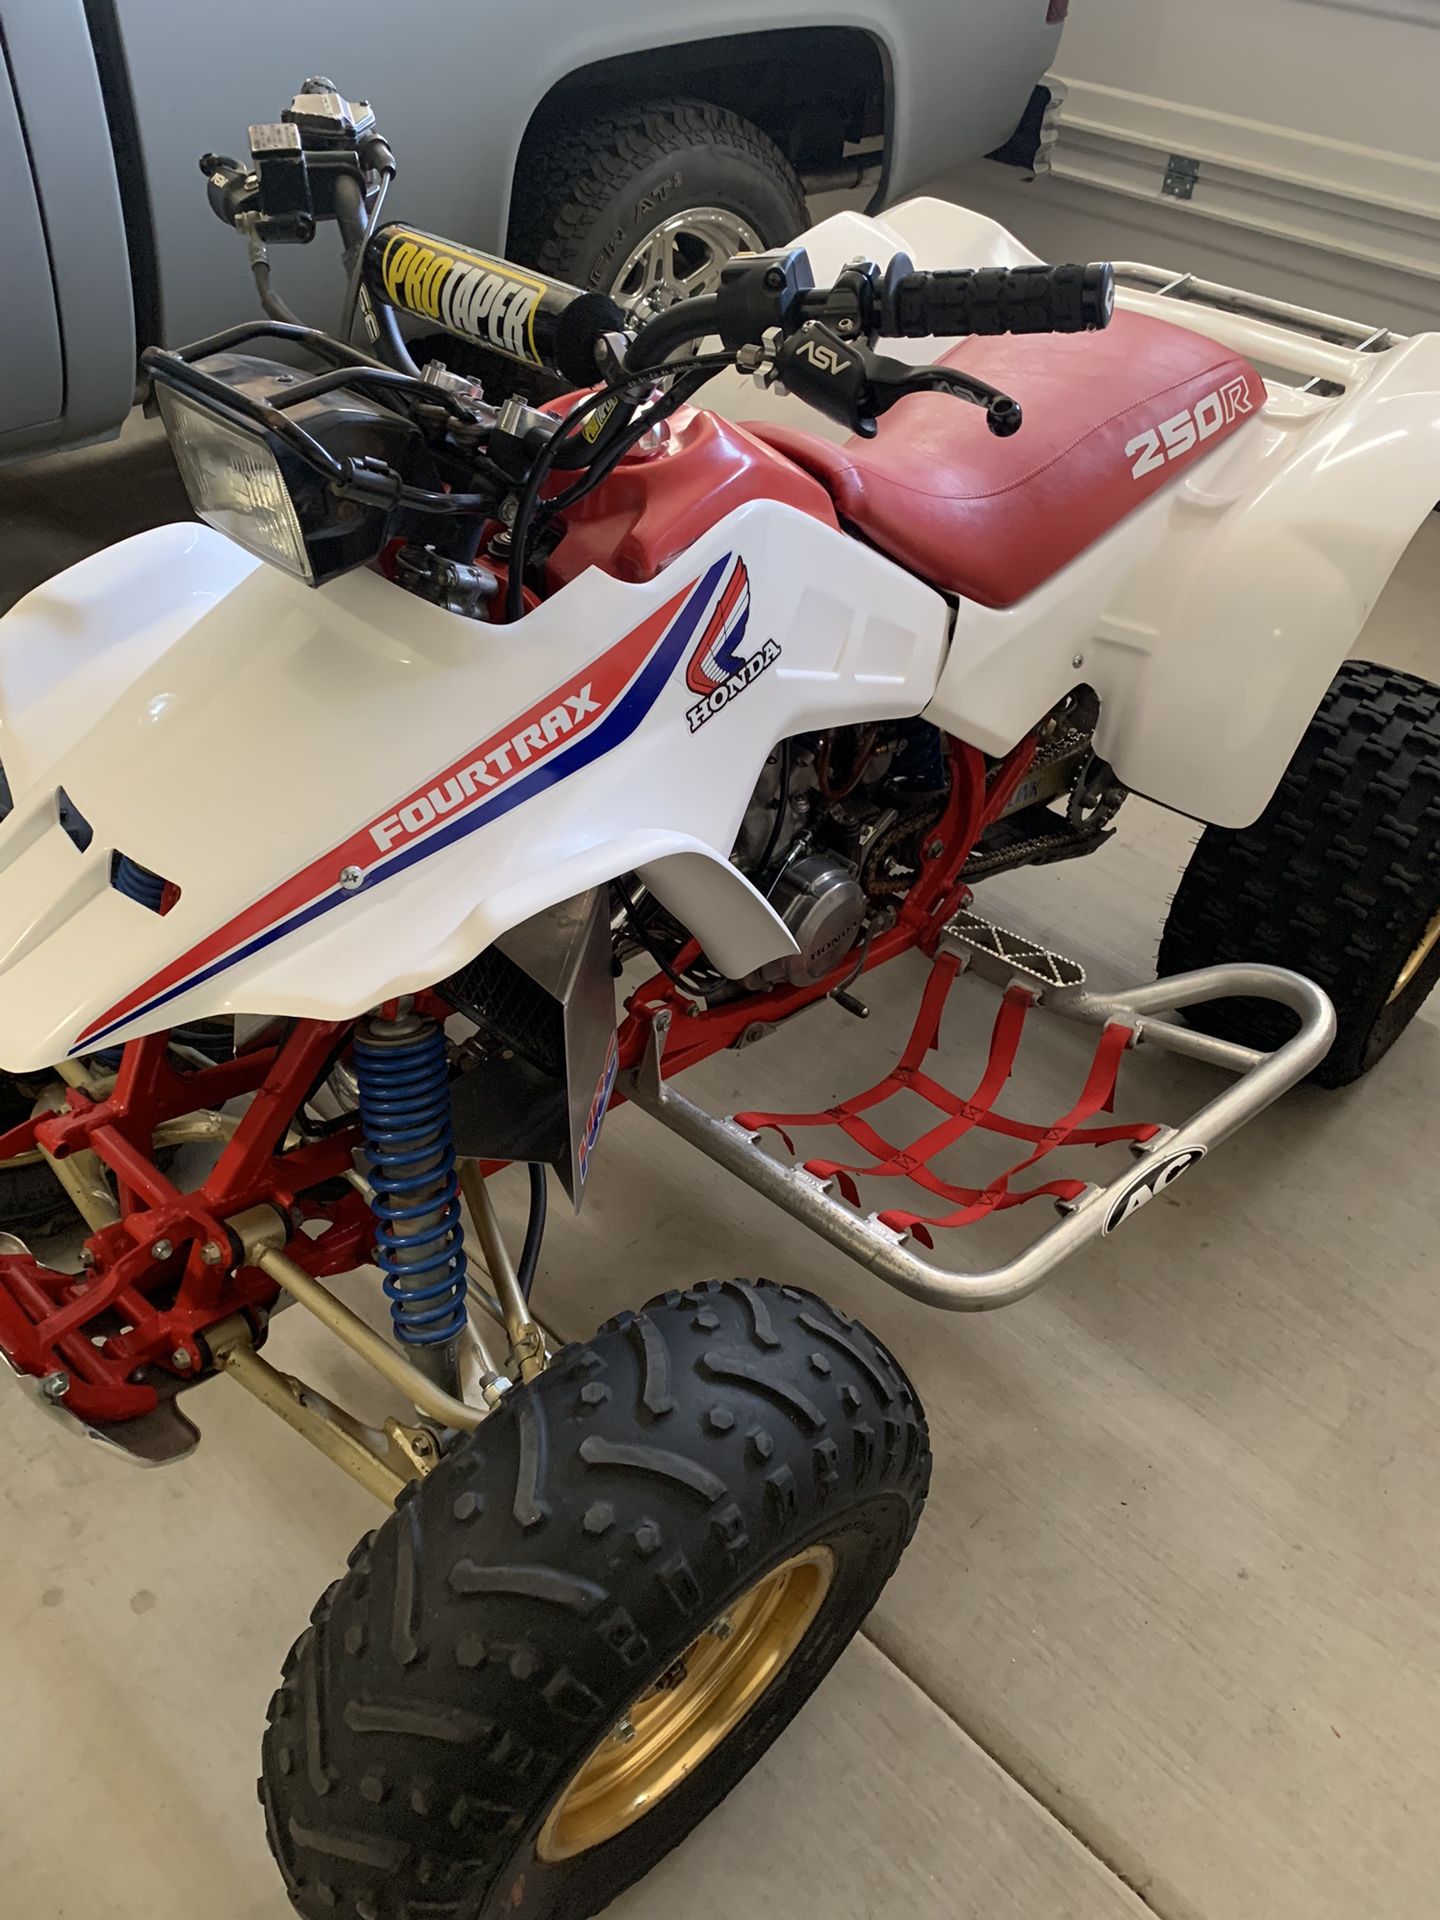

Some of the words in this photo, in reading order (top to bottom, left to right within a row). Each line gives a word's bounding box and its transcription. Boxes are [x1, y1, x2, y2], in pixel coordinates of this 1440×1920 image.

[388, 241, 539, 362] PROTAPER
[796, 341, 851, 376] ASV
[1125, 375, 1253, 480] 250R
[686, 638, 782, 734] HONDA
[368, 682, 602, 852] FOURTRAX
[810, 921, 858, 960] HONDA
